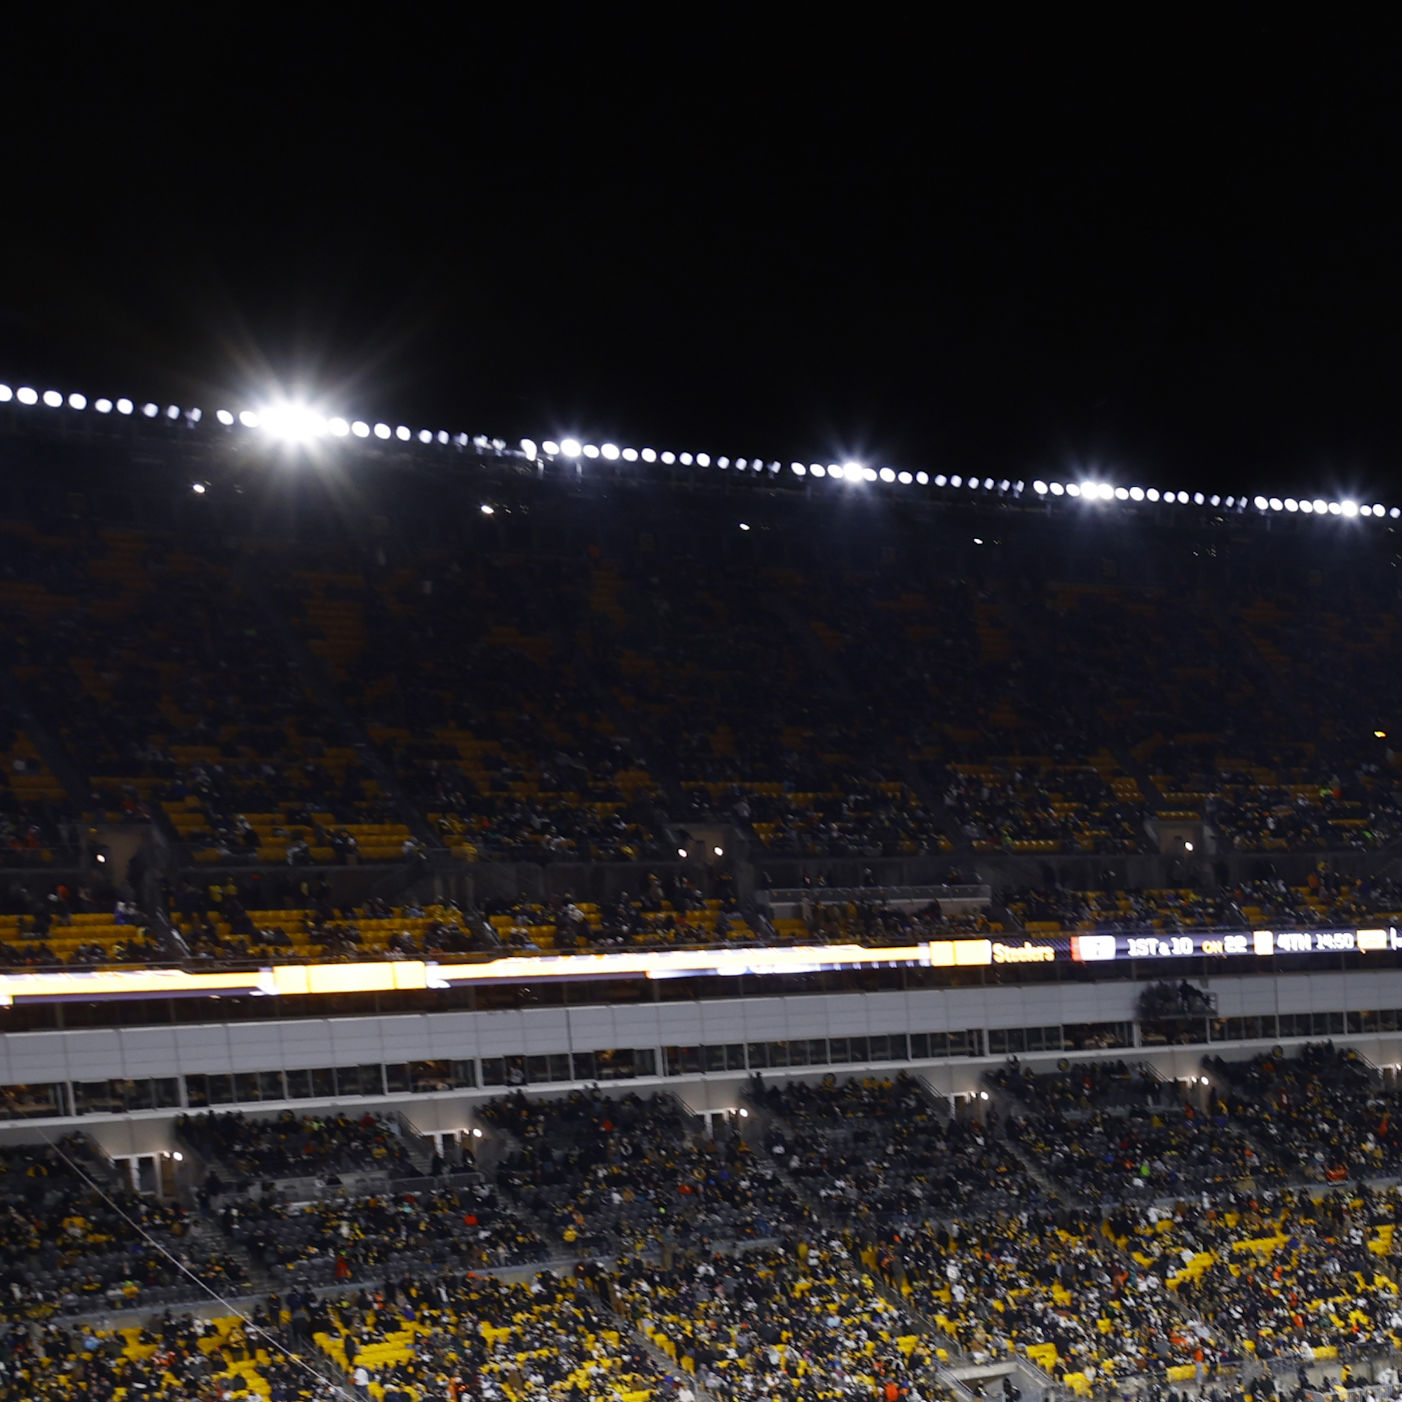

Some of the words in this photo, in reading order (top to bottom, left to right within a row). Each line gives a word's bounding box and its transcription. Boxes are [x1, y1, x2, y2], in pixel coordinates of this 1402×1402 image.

[992, 941, 1055, 964] Steelers
[1127, 937, 1159, 957] 1ST
[1171, 936, 1194, 955] 10
[1202, 940, 1223, 954] ON
[1277, 932, 1312, 951] 4TH
[1315, 932, 1354, 950] 14:50
